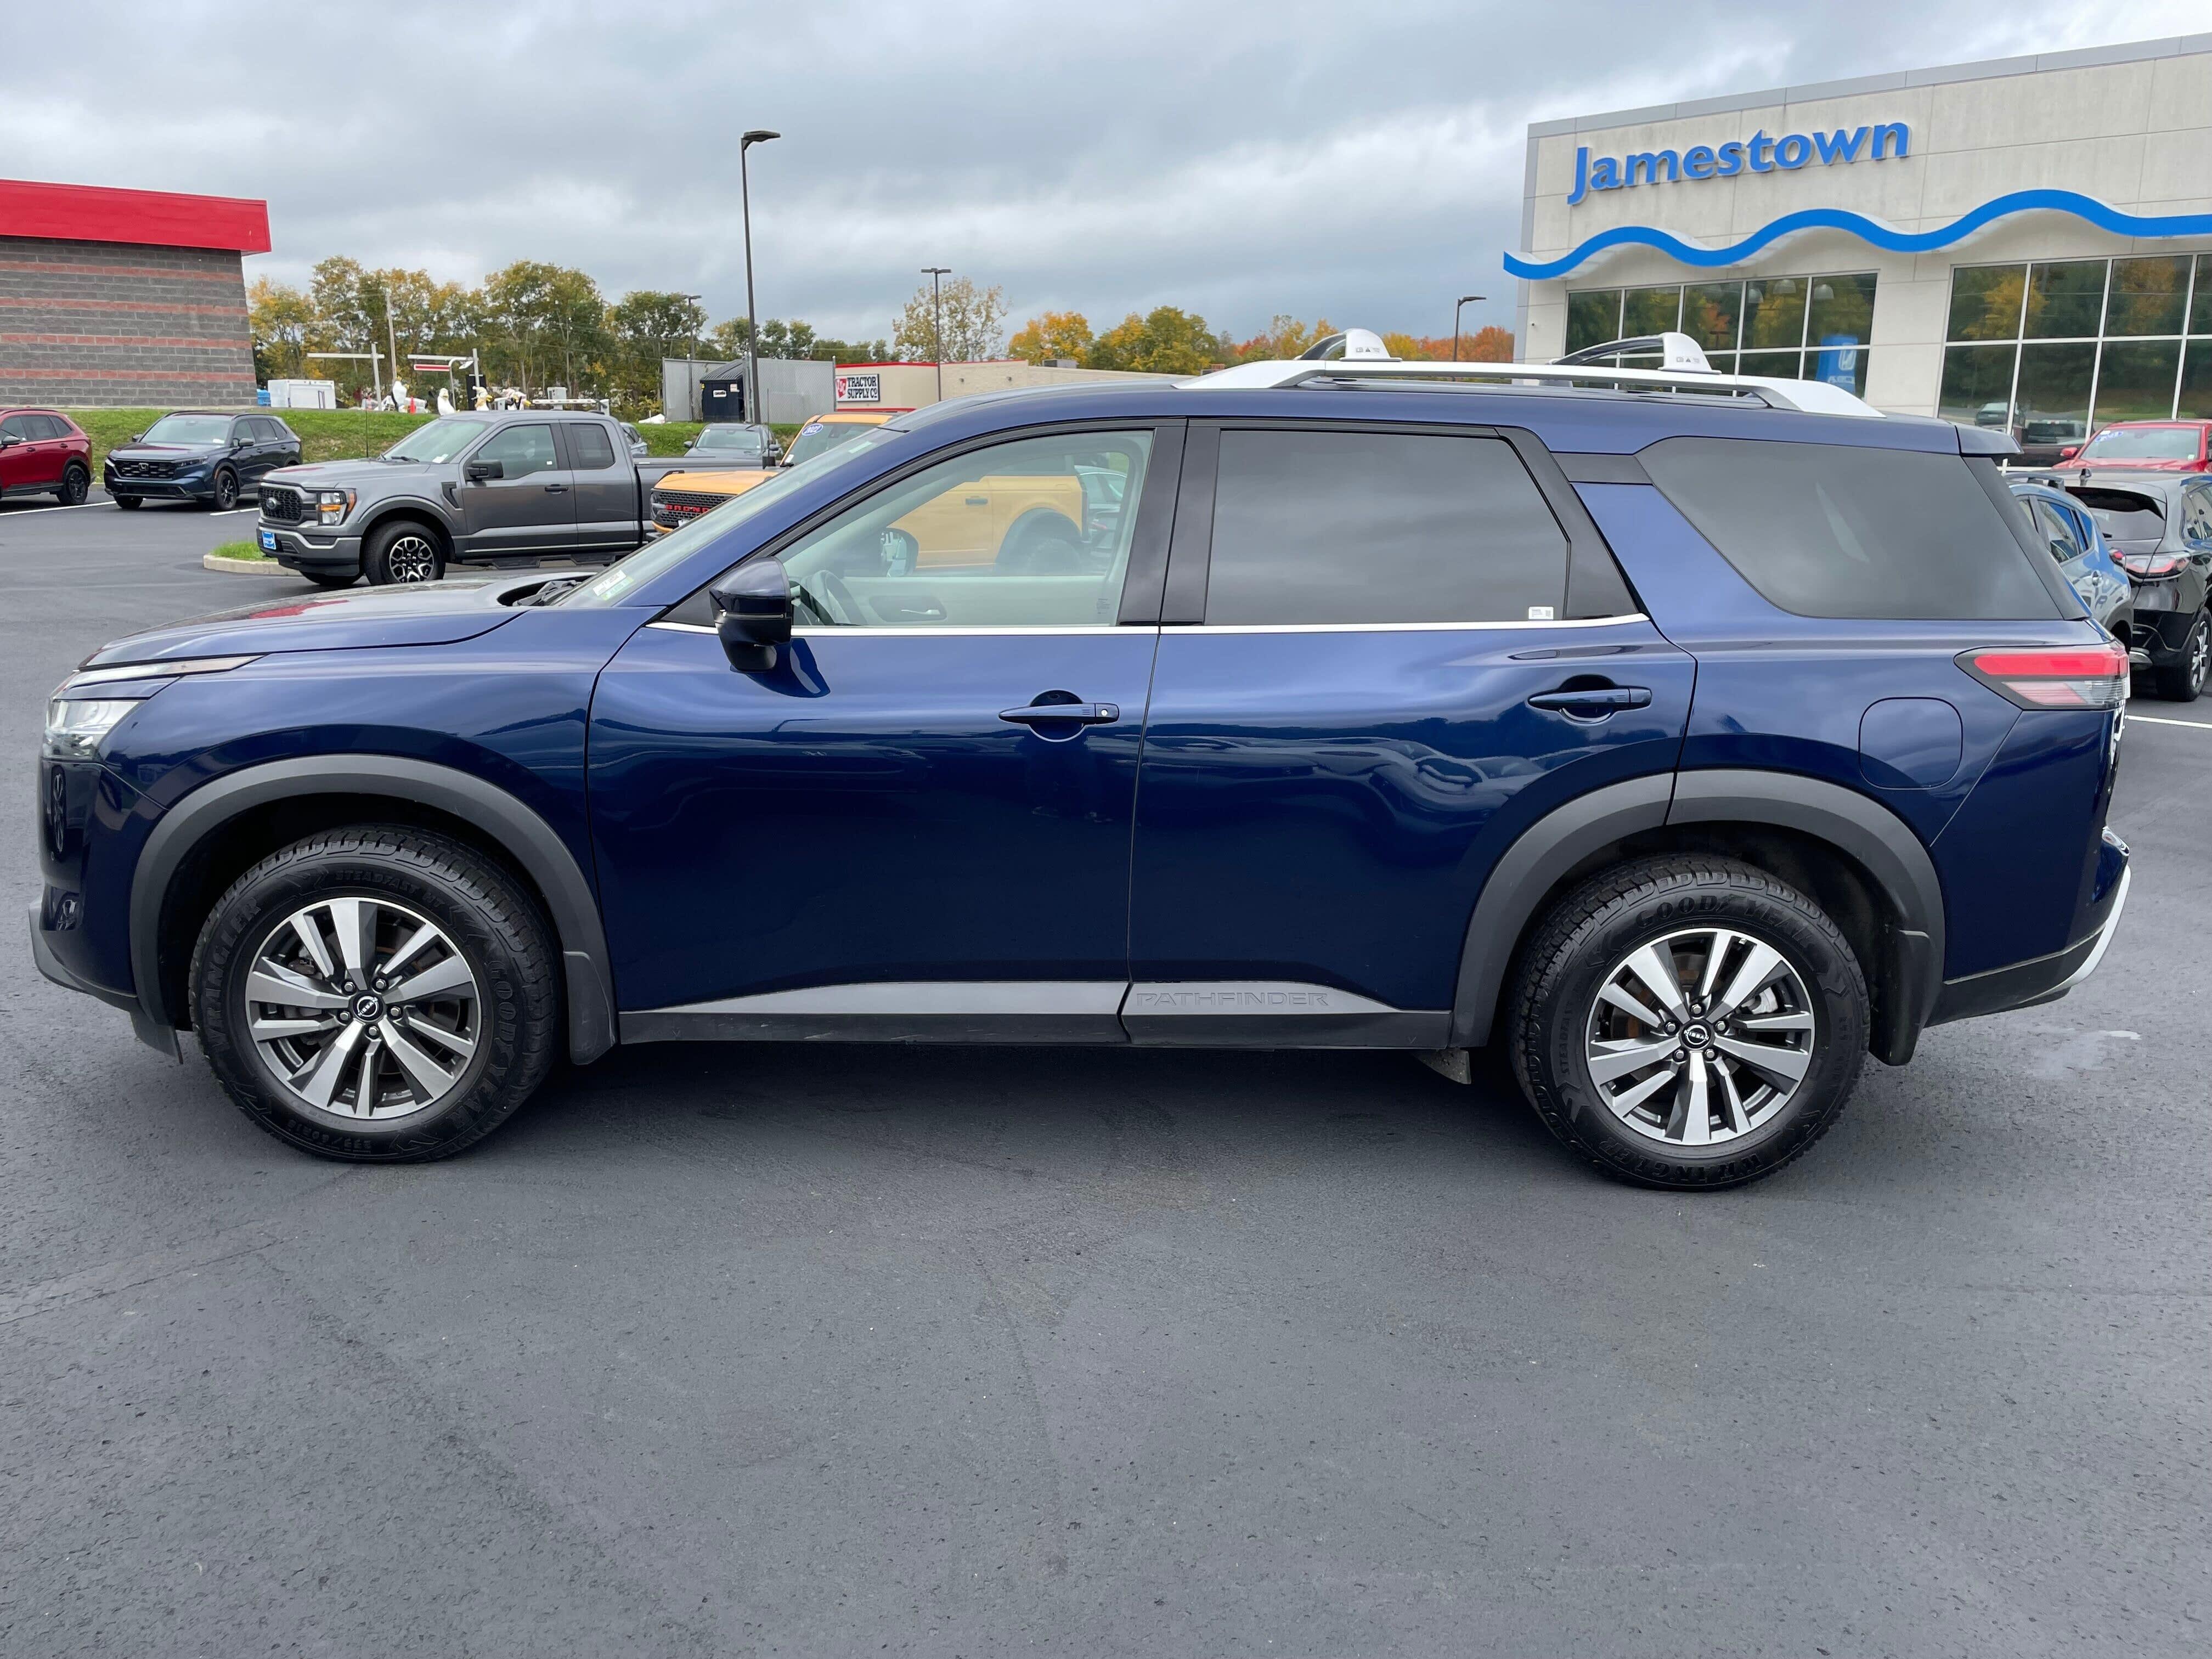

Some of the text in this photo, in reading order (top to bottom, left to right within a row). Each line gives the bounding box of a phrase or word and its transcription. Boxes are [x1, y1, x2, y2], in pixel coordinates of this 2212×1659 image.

[1567, 122, 1910, 205] Jamestown
[847, 376, 877, 387] TRACTOR
[848, 388, 869, 398] SUPPLY
[1635, 894, 1816, 947] GOODYEAR
[358, 997, 378, 1017] NISSAN
[1136, 992, 1329, 1006] PATHFINDER
[1684, 1029, 1709, 1041] NISSAN
[446, 960, 517, 1128] GOODYEAR
